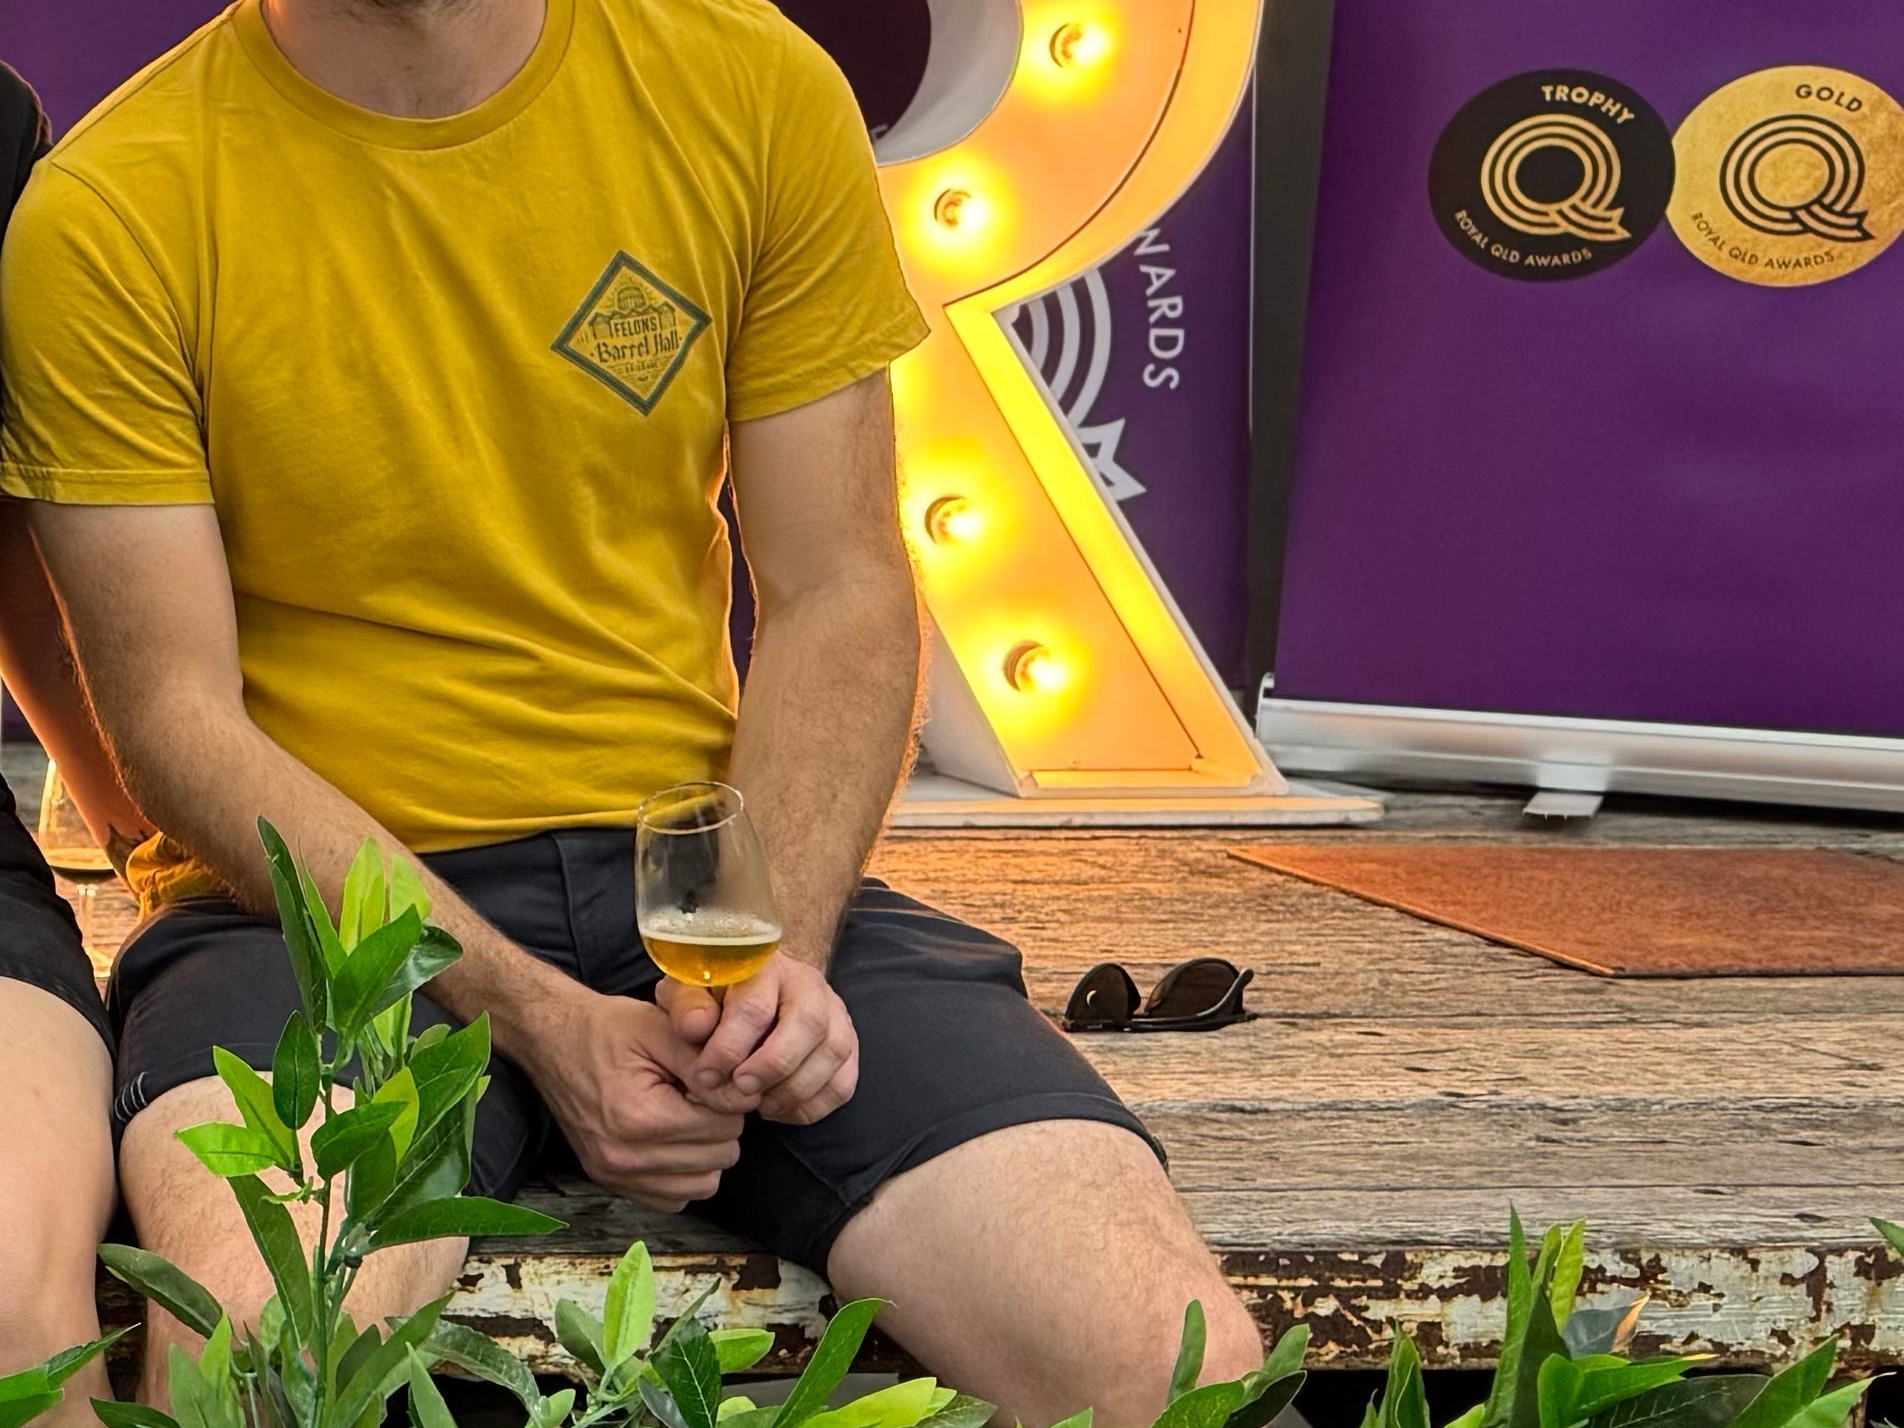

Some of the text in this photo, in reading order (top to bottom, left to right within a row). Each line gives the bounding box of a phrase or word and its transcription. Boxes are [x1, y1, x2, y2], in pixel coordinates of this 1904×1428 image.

[1541, 83, 1635, 126] TROPHY
[1794, 83, 1864, 114] GOLD
[1454, 209, 1592, 268] ROYAL QLD AWARDS
[1692, 211, 1836, 270] ROYAL QLD AWARDS
[1132, 209, 1187, 391] WARDS
[614, 316, 658, 338] FELONS
[597, 334, 650, 364] Barrel
